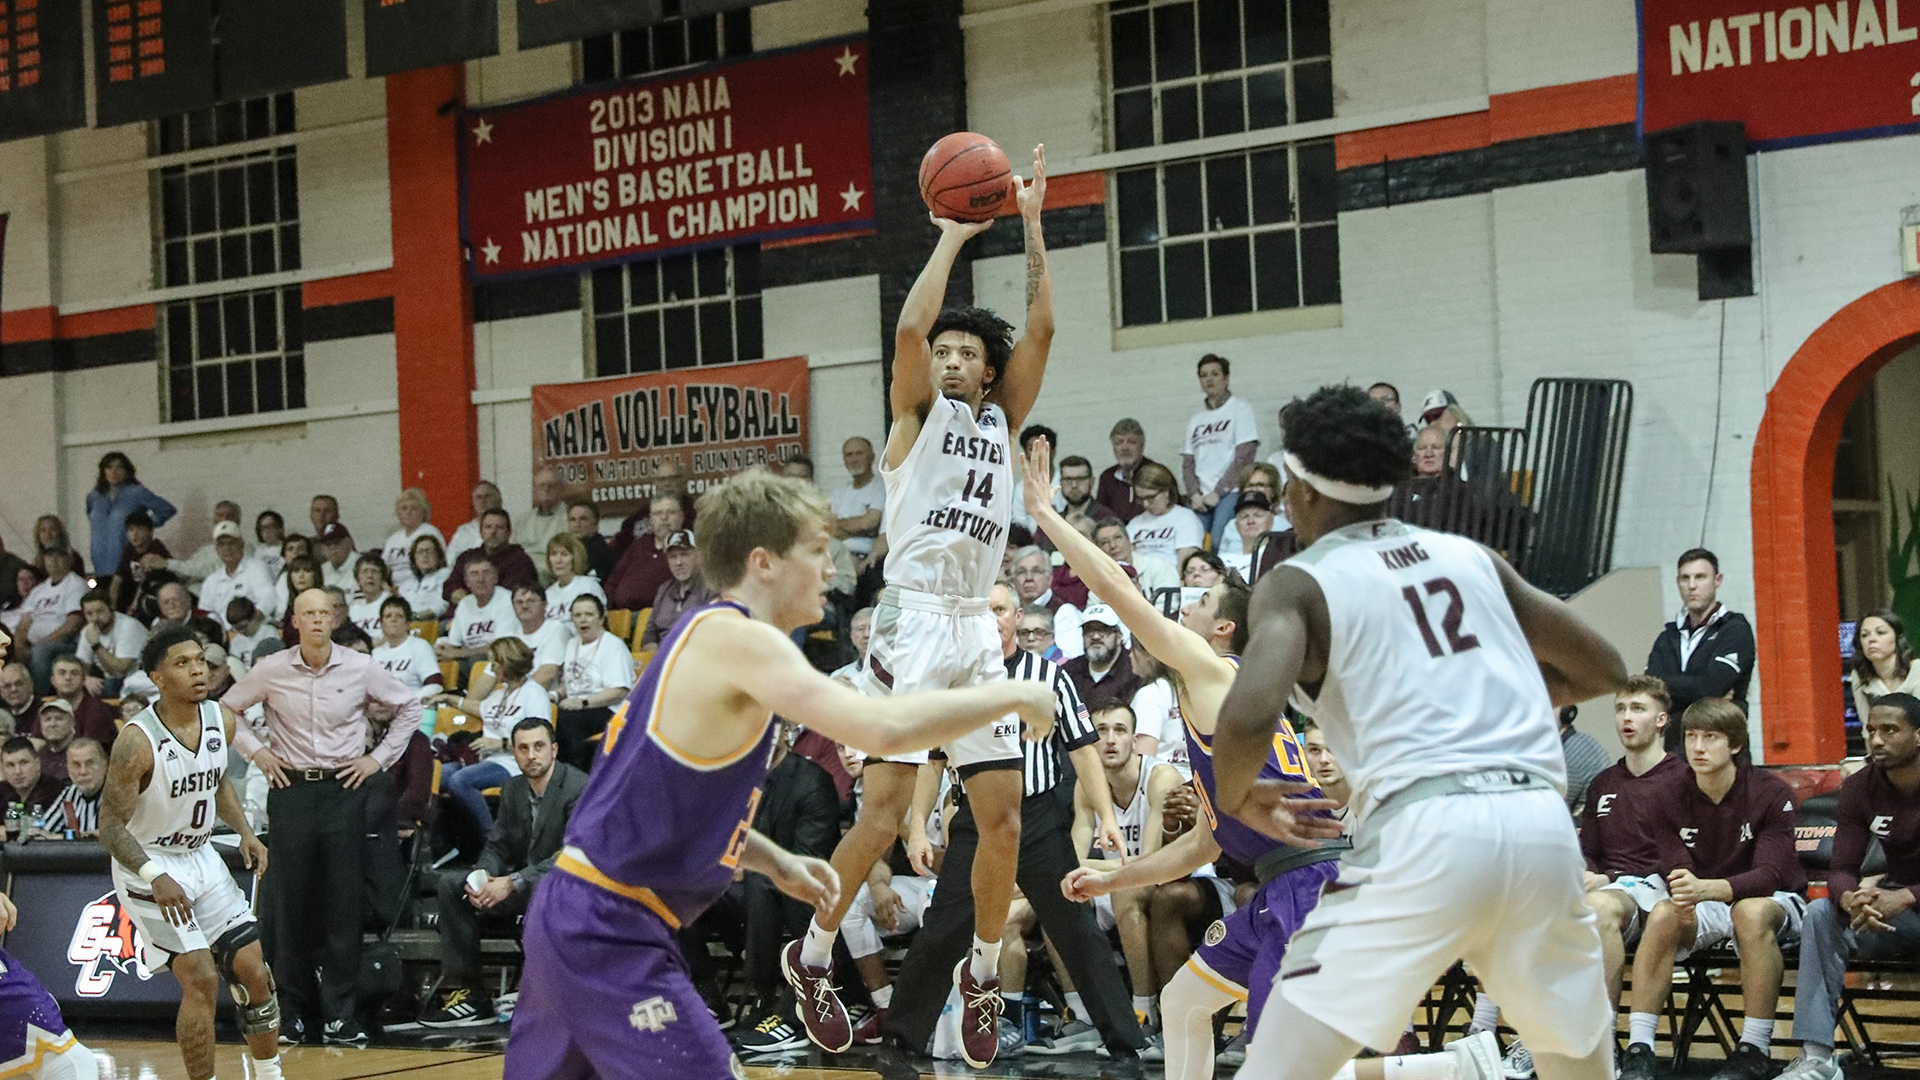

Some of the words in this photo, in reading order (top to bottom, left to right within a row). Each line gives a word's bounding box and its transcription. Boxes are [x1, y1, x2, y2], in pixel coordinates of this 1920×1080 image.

[1669, 0, 1918, 75] NATIONAL
[589, 90, 654, 134] 2013
[663, 76, 731, 120] NAIA
[593, 118, 715, 172] DIVISION
[723, 115, 732, 149] I
[524, 177, 610, 225] MEN'S
[618, 143, 813, 207] BASKETBALL
[521, 211, 659, 263] NATIONAL
[667, 184, 819, 240] CHAMPION
[543, 401, 610, 459] NAIA
[612, 383, 801, 453] VOLLEYBALL
[1192, 420, 1231, 438] EKU
[593, 453, 685, 483] NATIONL
[961, 469, 994, 508] 14
[1377, 541, 1430, 570] KING
[1402, 577, 1482, 658] 12
[190, 799, 208, 830] 0
[1598, 793, 1618, 813] E
[1739, 822, 1753, 843] 24
[1869, 815, 1894, 836] E
